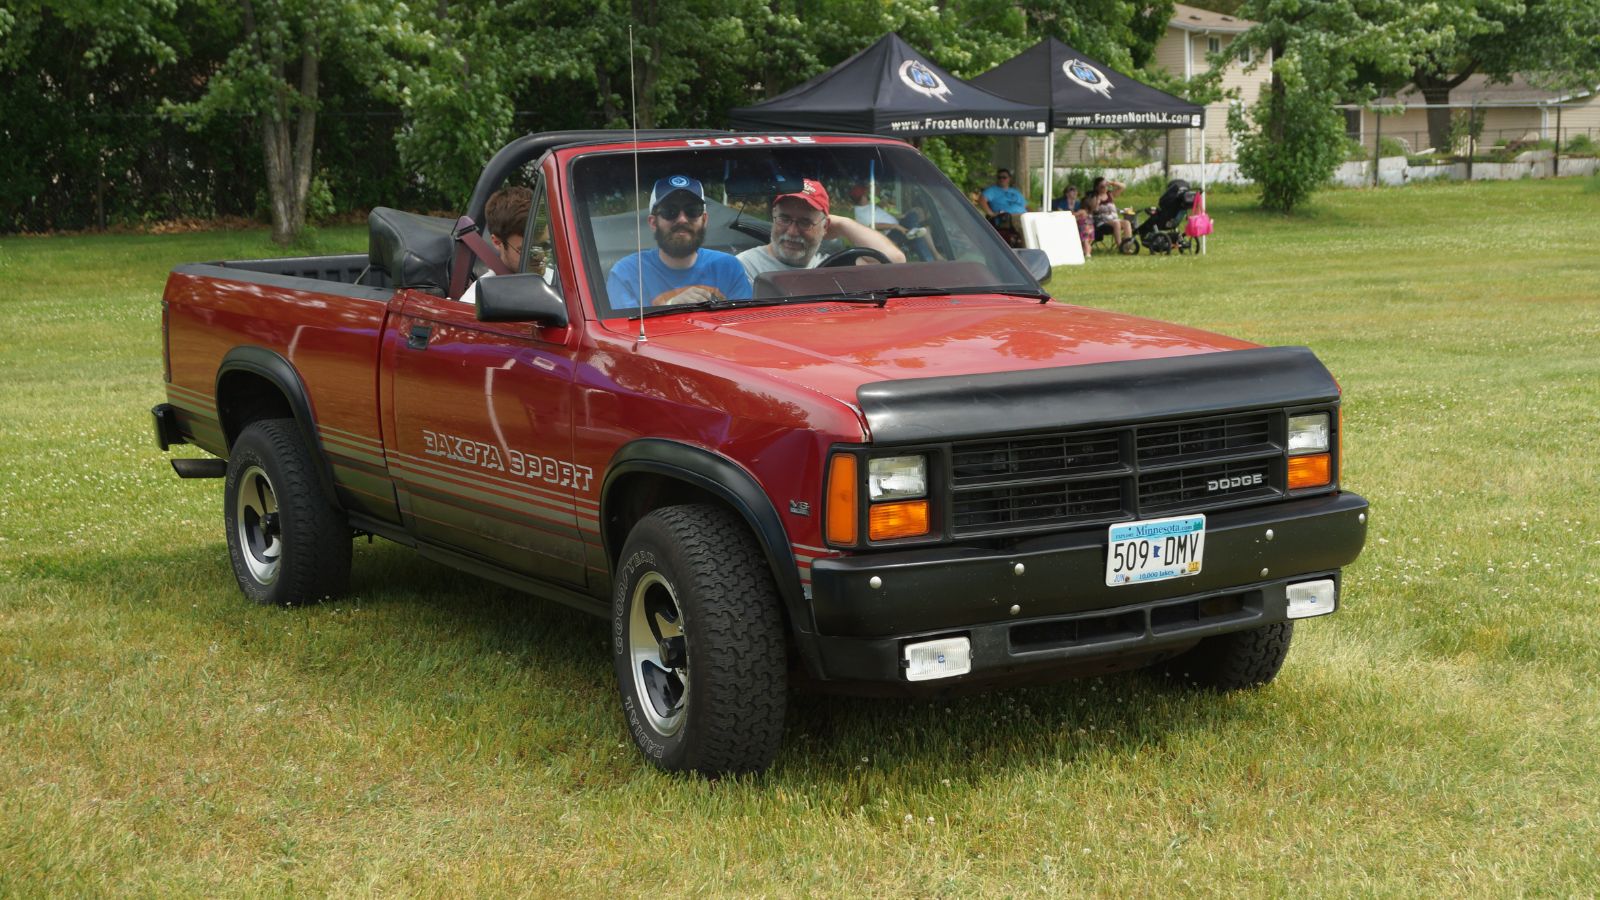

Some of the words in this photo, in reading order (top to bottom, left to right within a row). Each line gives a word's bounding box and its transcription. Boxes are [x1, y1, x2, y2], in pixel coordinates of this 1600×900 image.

[891, 117, 1035, 131] www.FrozenNorthLX.com
[1067, 112, 1190, 126] www.FrozenNorthLX.com
[686, 136, 816, 148] DODGE
[508, 449, 593, 492] SPORT
[1207, 473, 1263, 491] DODGE
[1113, 540, 1150, 573] 509
[1164, 533, 1200, 566] DMV
[614, 550, 657, 655] GOODYEAR
[625, 695, 665, 759] RADIAL
